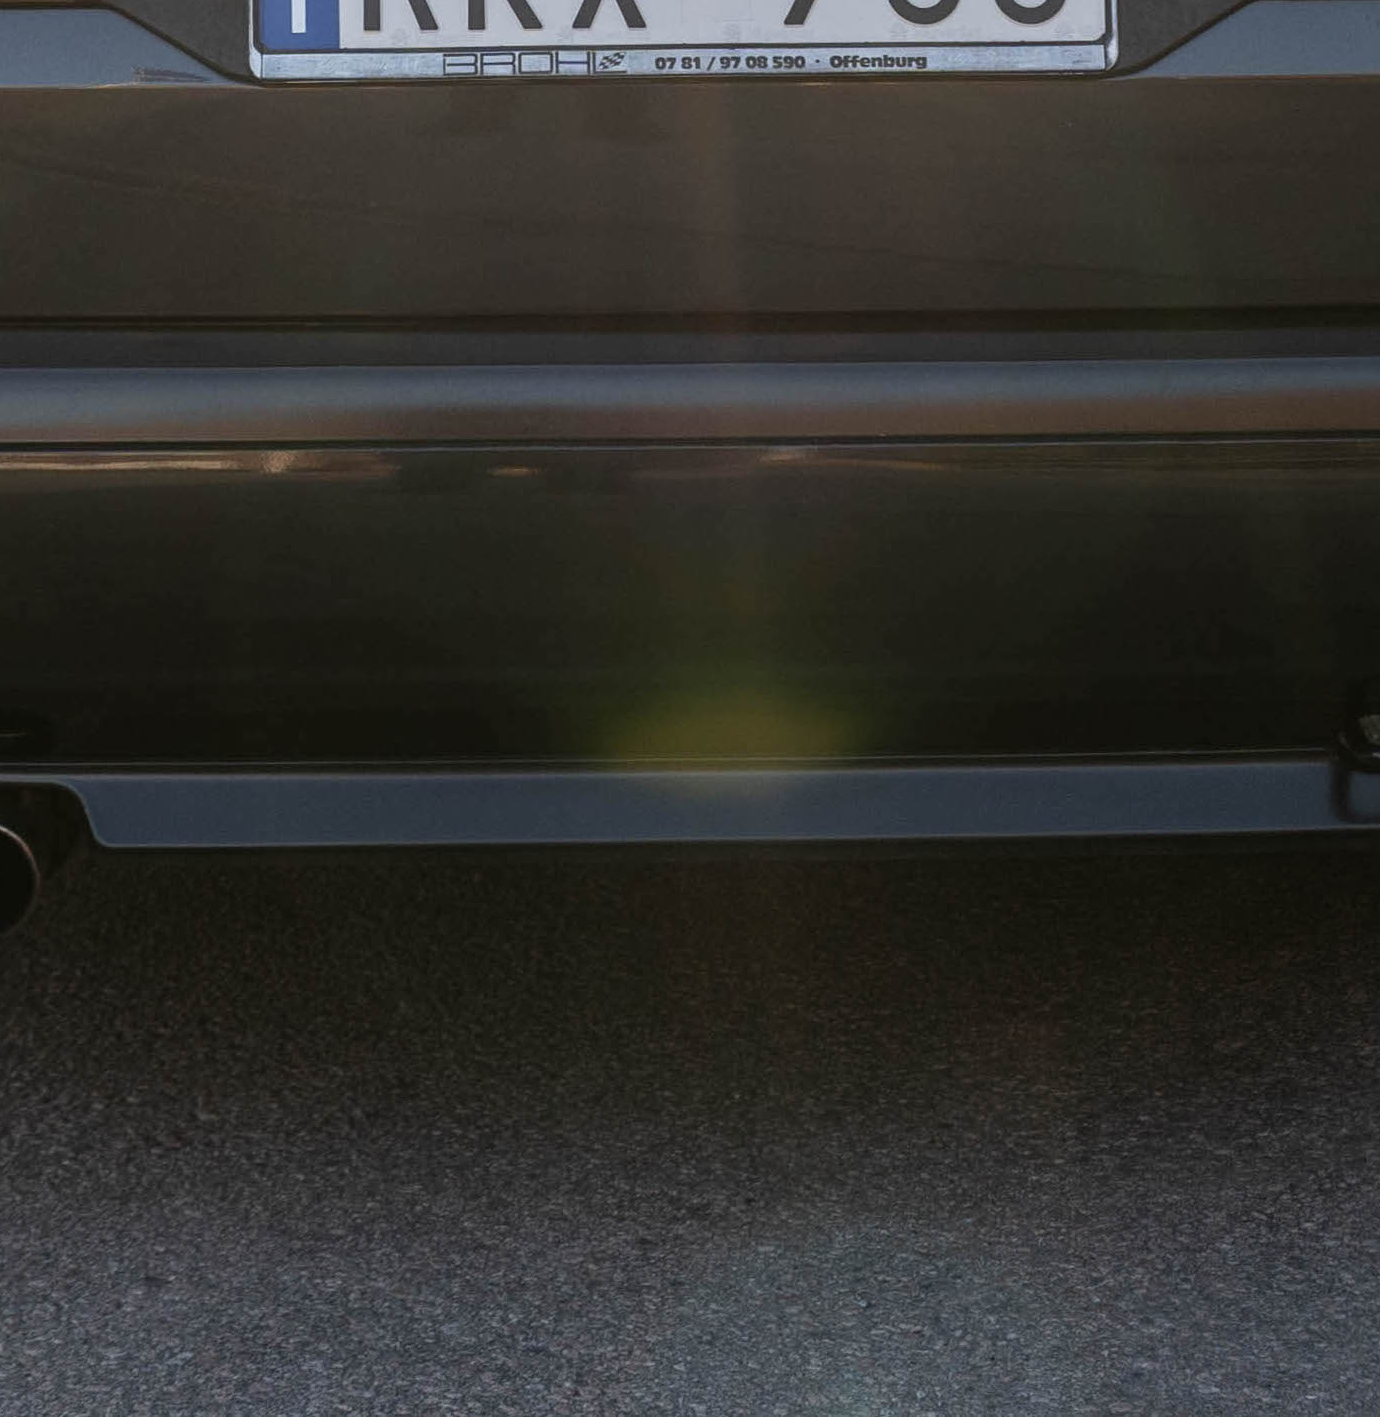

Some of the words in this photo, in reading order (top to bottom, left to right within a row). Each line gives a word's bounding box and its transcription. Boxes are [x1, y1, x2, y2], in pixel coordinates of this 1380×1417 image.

[655, 56, 676, 70] 07
[681, 56, 700, 70] 81
[720, 56, 741, 69] 97
[746, 56, 768, 68] 08
[772, 55, 806, 68] 590
[830, 54, 928, 69] Offenburg
